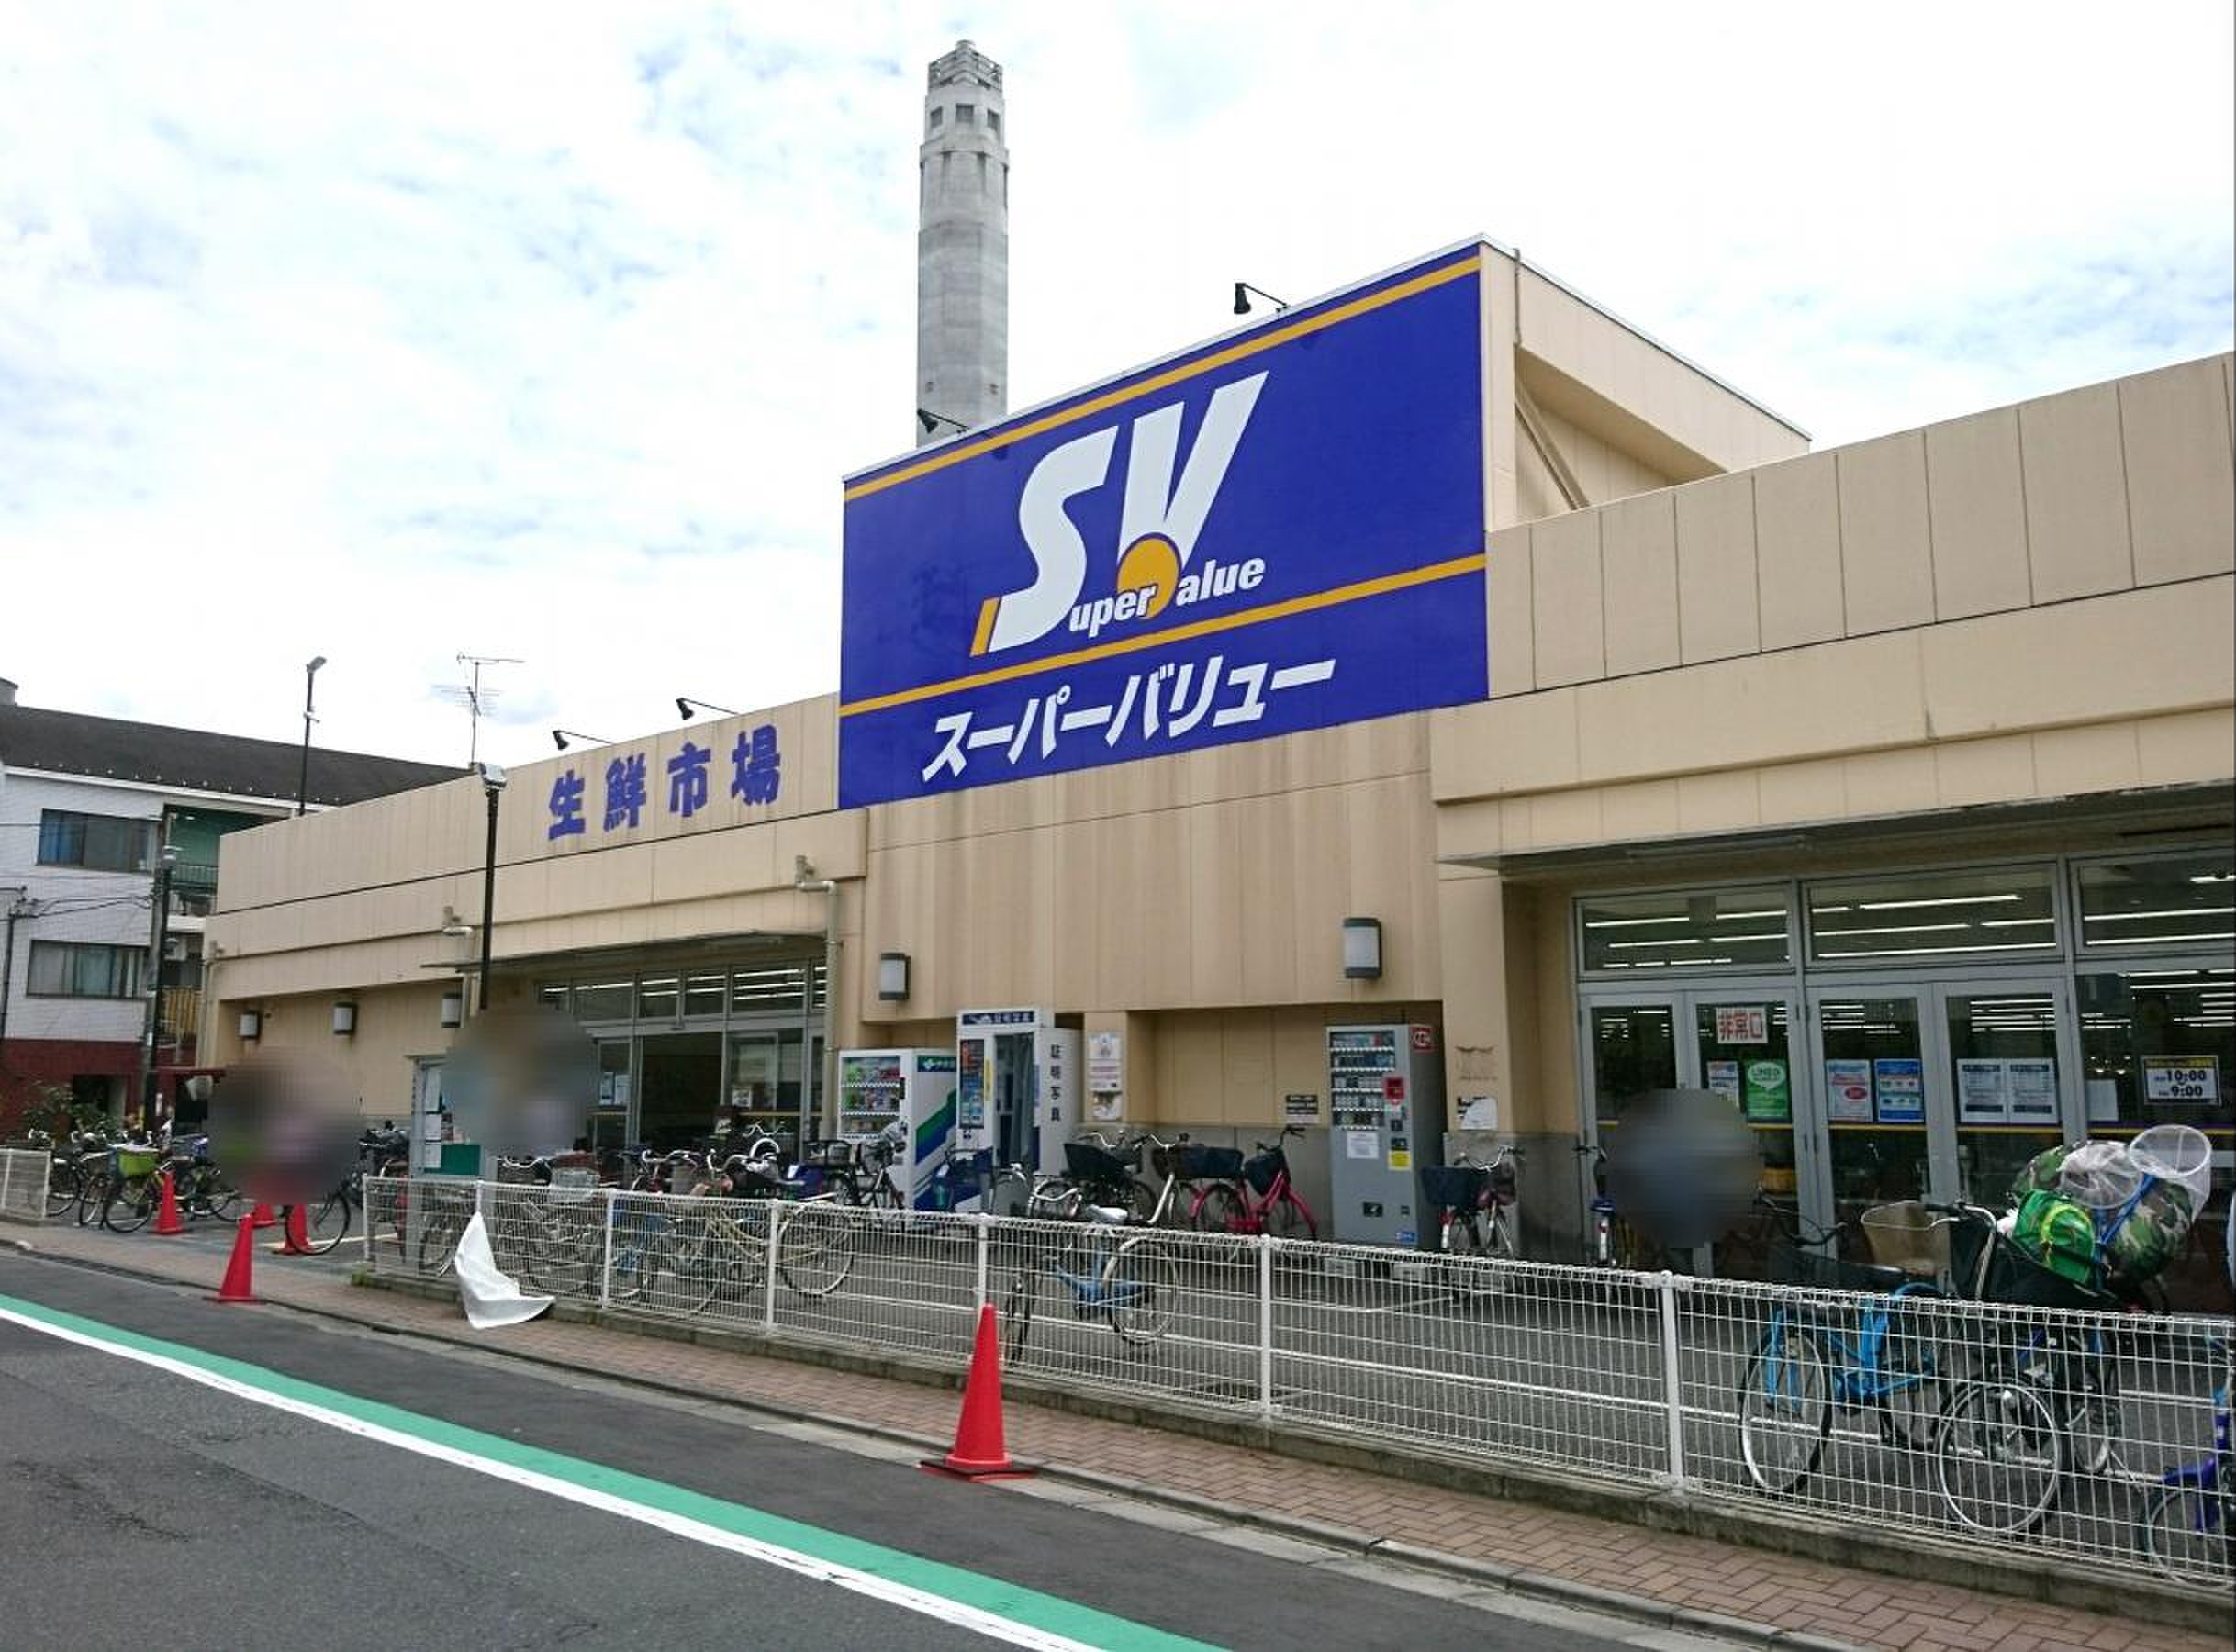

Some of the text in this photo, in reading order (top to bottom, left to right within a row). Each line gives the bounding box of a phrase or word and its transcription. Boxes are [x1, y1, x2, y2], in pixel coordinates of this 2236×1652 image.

[922, 655, 1336, 782] スーパーバリュー
[548, 724, 781, 841] 生鮮市場
[2167, 1069, 2207, 1082] 10:00
[2171, 1085, 2203, 1097] 9:00
